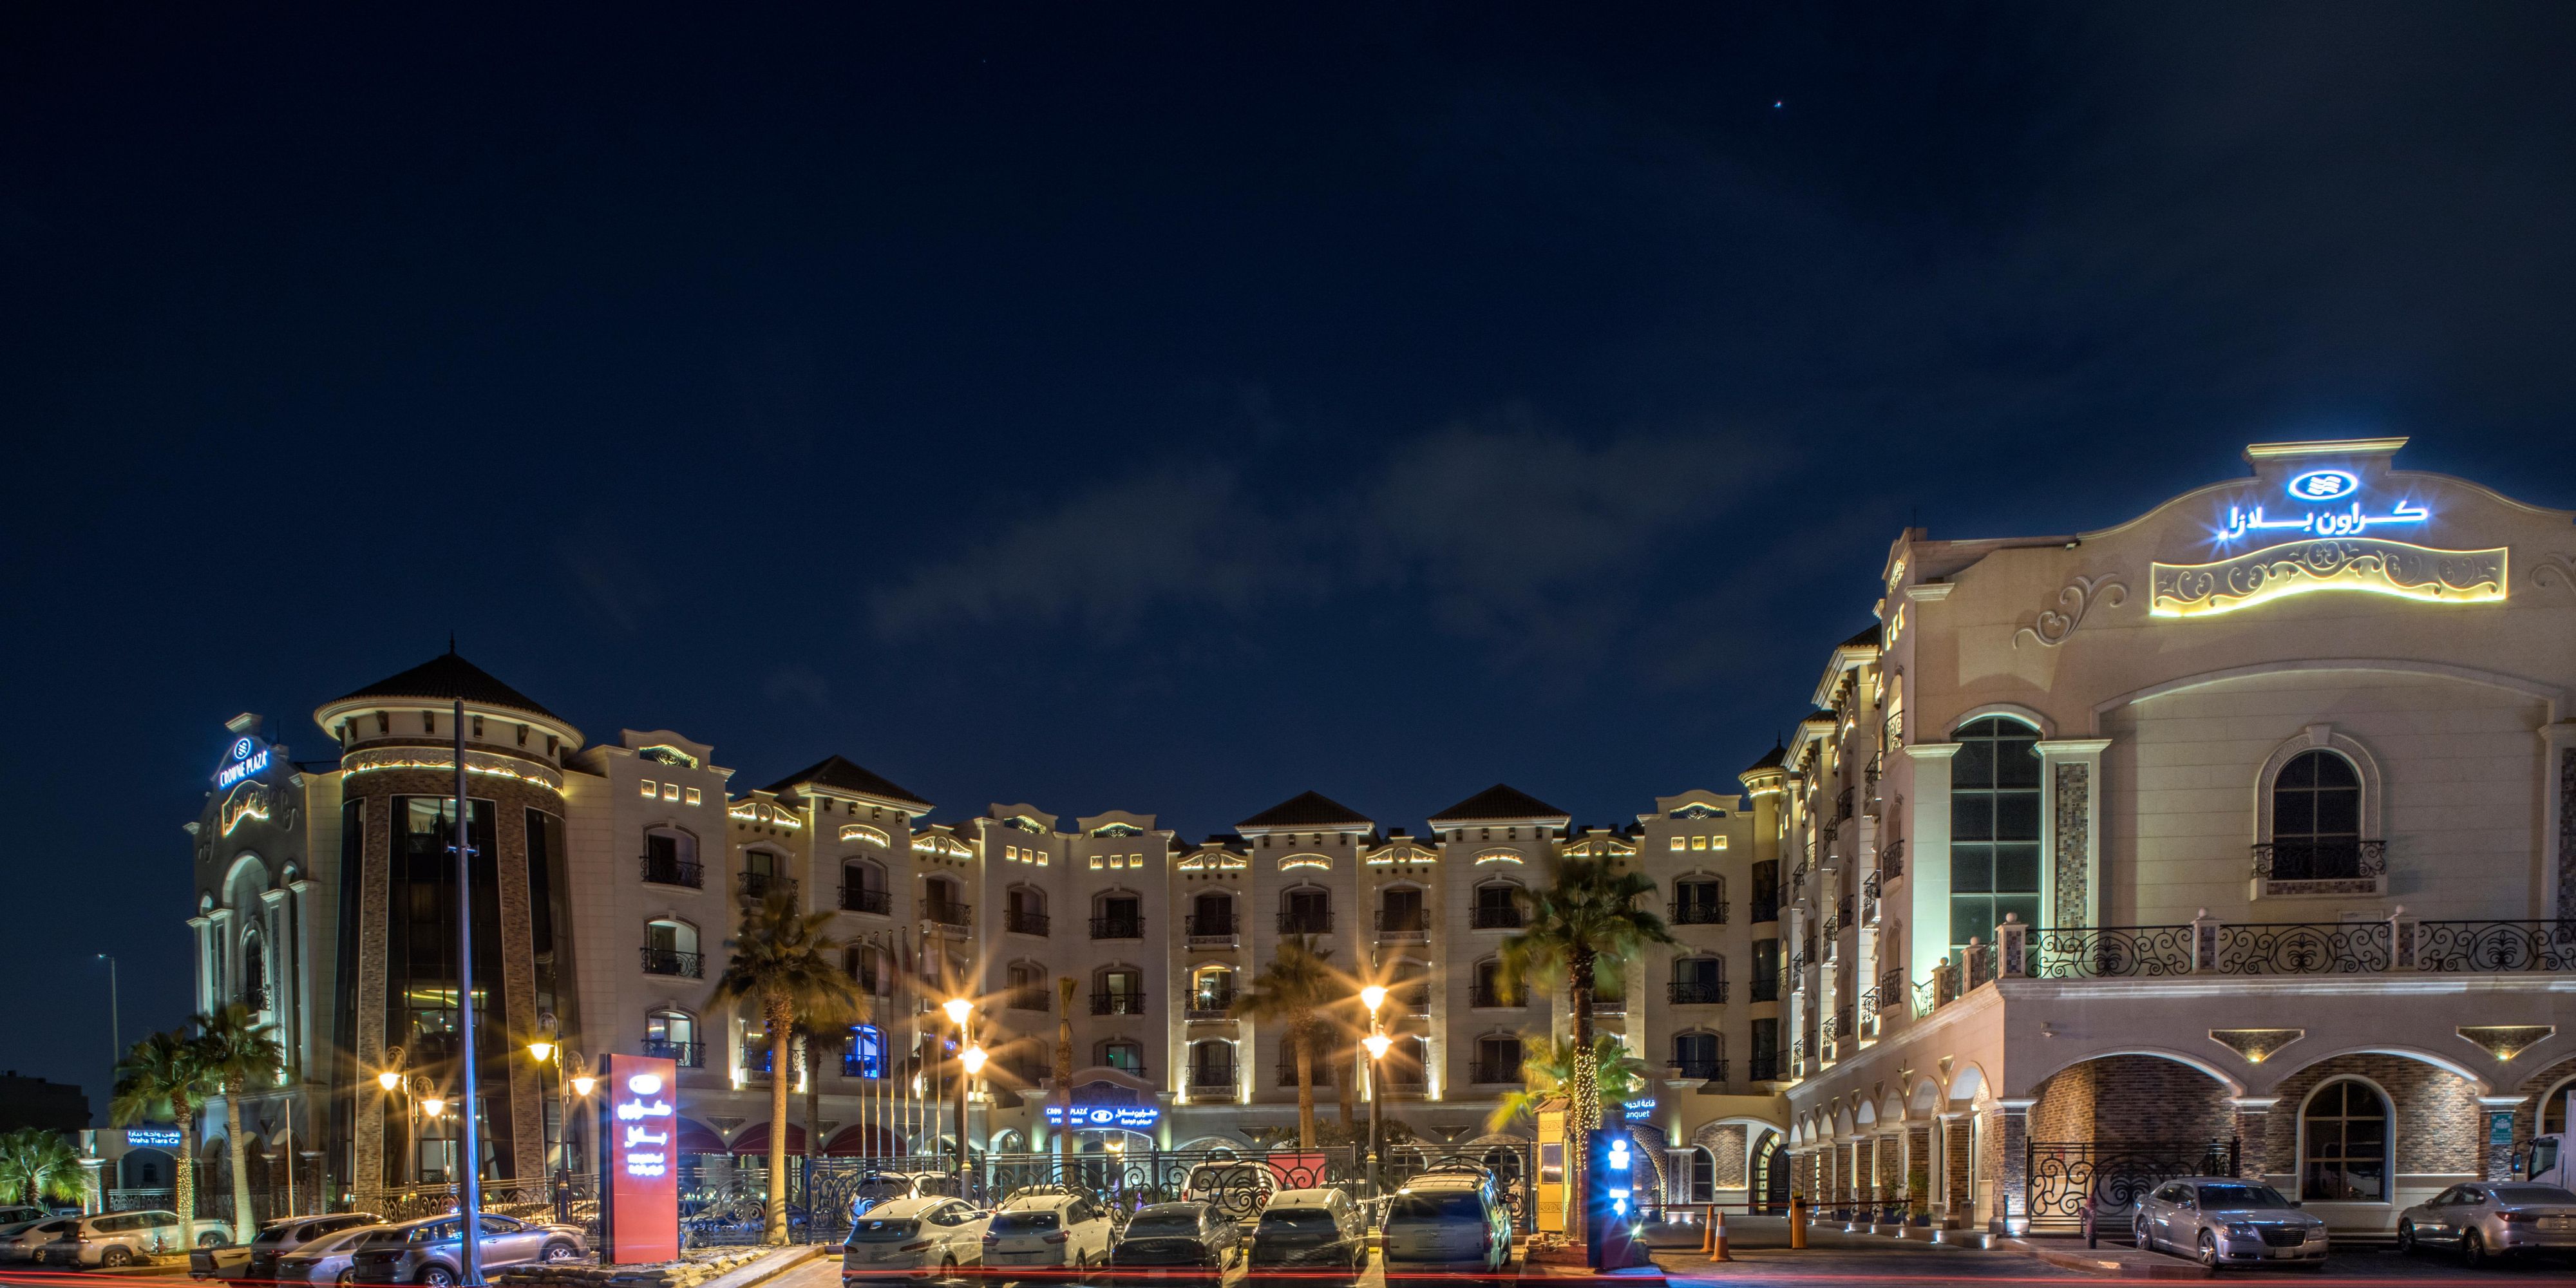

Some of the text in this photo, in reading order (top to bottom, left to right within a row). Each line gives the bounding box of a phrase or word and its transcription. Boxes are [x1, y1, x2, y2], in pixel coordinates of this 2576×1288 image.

[2228, 500, 2429, 538] كراون بلازا
[220, 751, 267, 787] CROWNE PLAZA
[1641, 1099, 1655, 1107] قاعة
[1626, 1110, 1650, 1119] anquet
